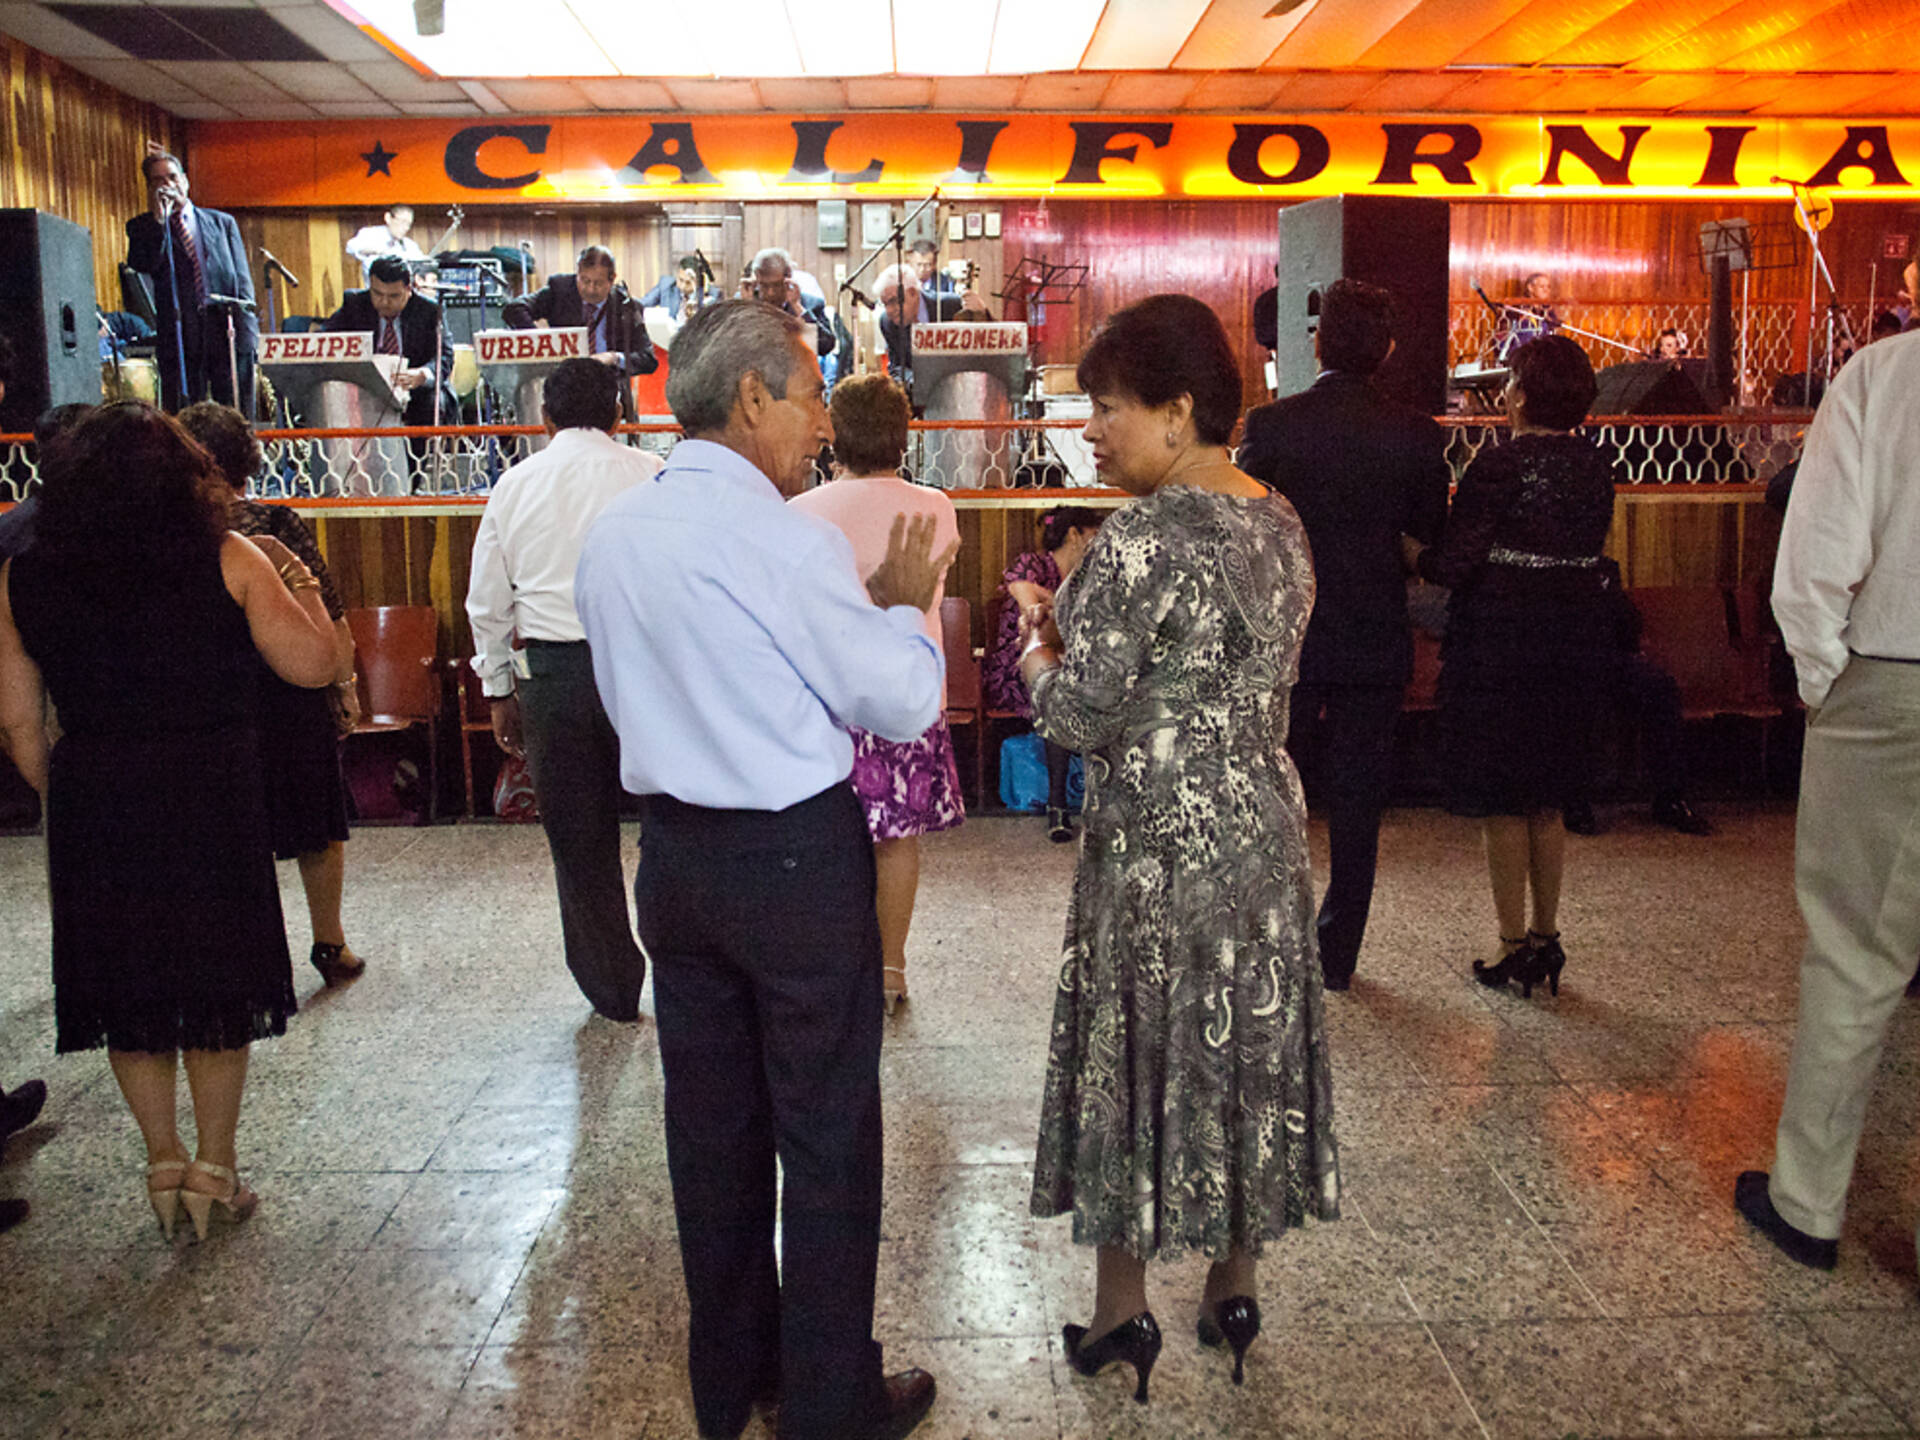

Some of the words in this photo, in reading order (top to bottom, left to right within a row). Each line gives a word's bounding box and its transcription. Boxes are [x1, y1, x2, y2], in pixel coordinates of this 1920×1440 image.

[444, 121, 1913, 189] CALIFORNIA
[264, 336, 362, 359] FELIPE
[479, 333, 579, 360] URBAN
